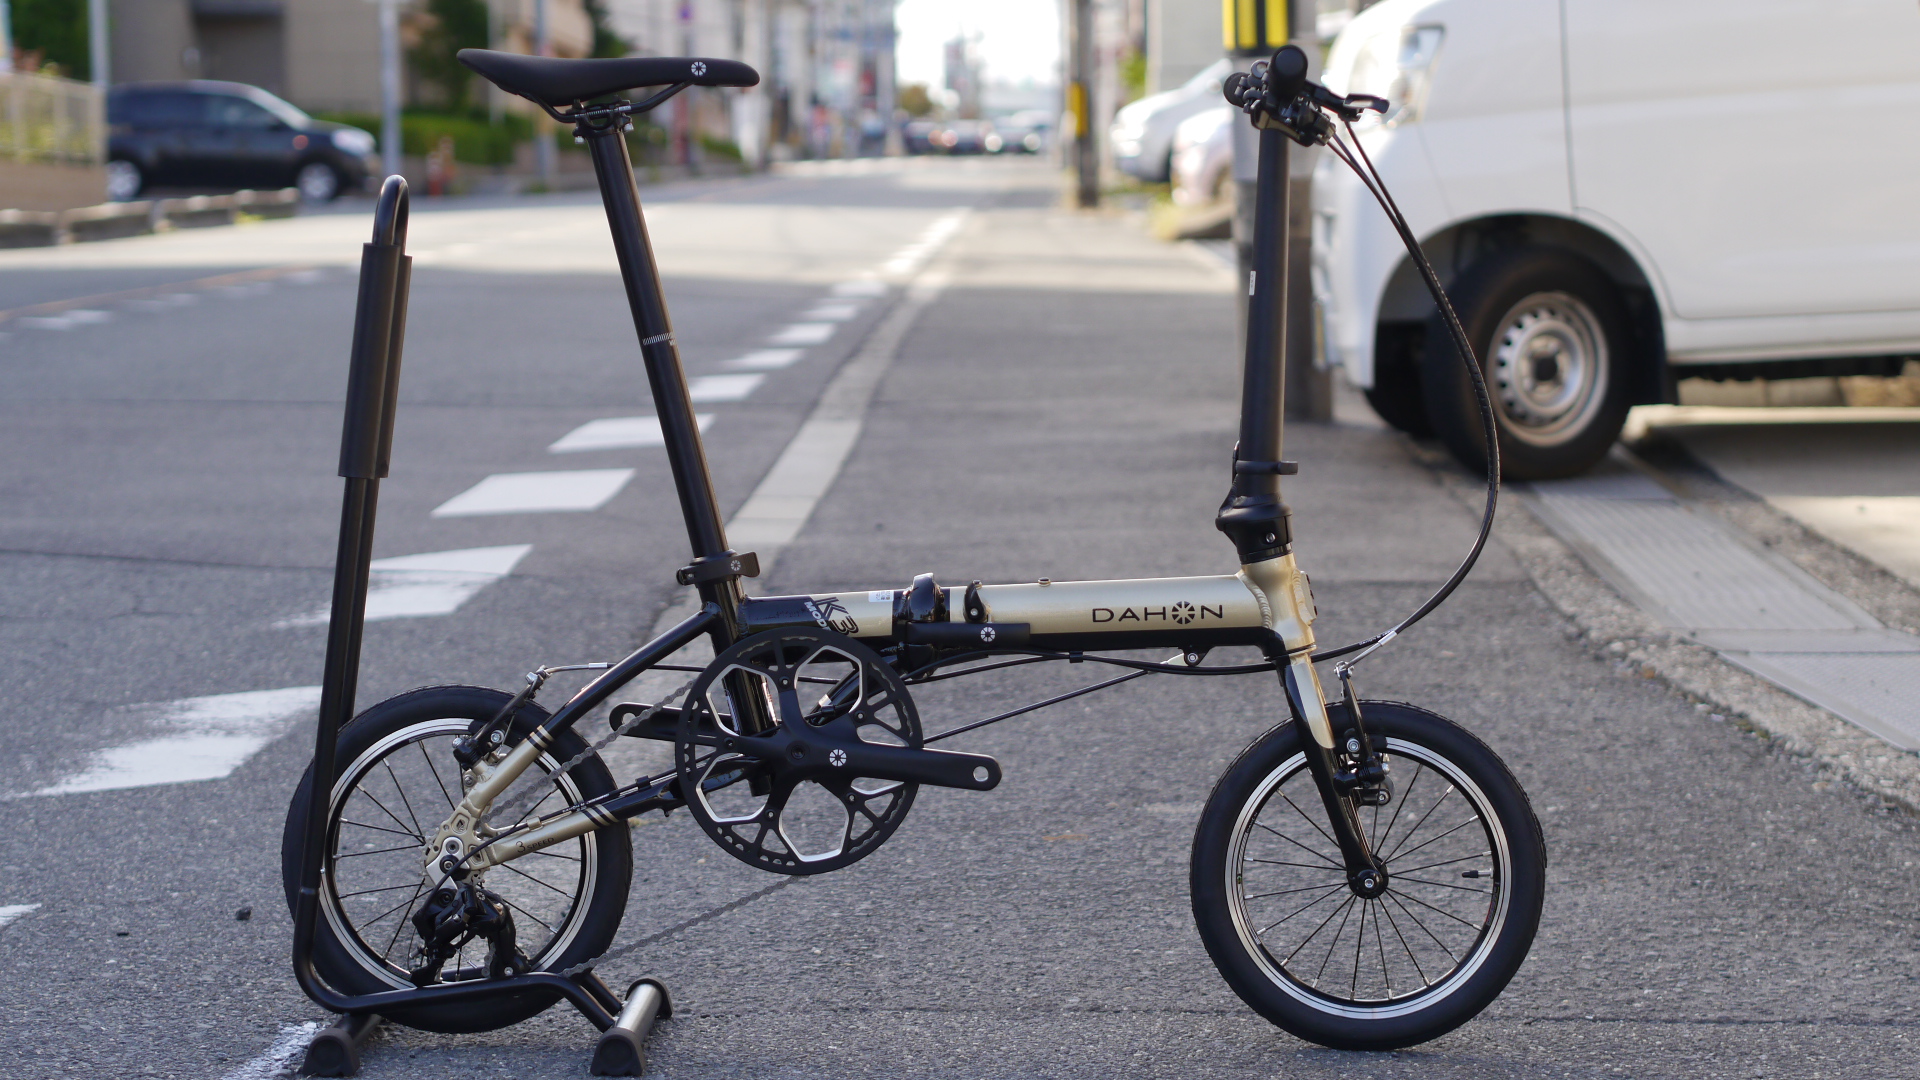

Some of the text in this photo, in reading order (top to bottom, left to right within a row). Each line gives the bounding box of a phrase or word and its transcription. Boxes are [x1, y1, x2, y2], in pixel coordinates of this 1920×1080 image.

[815, 596, 860, 635] K3
[1092, 601, 1223, 625] DAHON
[515, 837, 555, 853] 3 SPEED
